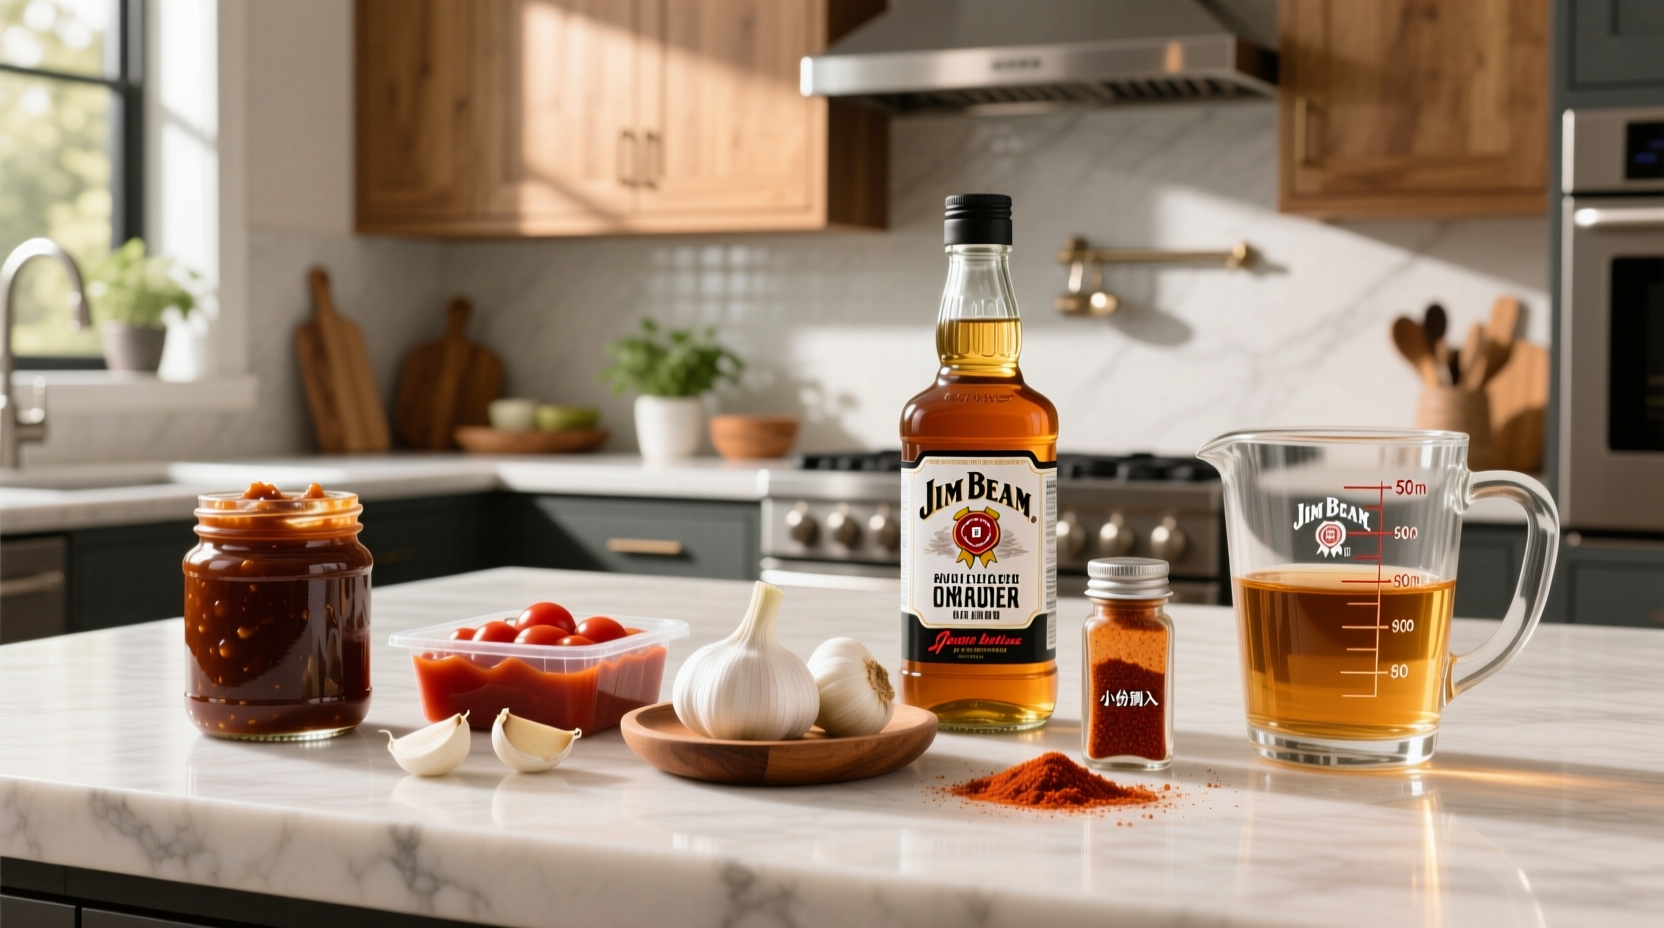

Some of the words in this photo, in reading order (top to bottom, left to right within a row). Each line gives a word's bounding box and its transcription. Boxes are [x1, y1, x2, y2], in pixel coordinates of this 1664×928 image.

[919, 478, 964, 520] JIM
[967, 471, 1032, 518] BEAM
[1293, 501, 1324, 531] JIM
